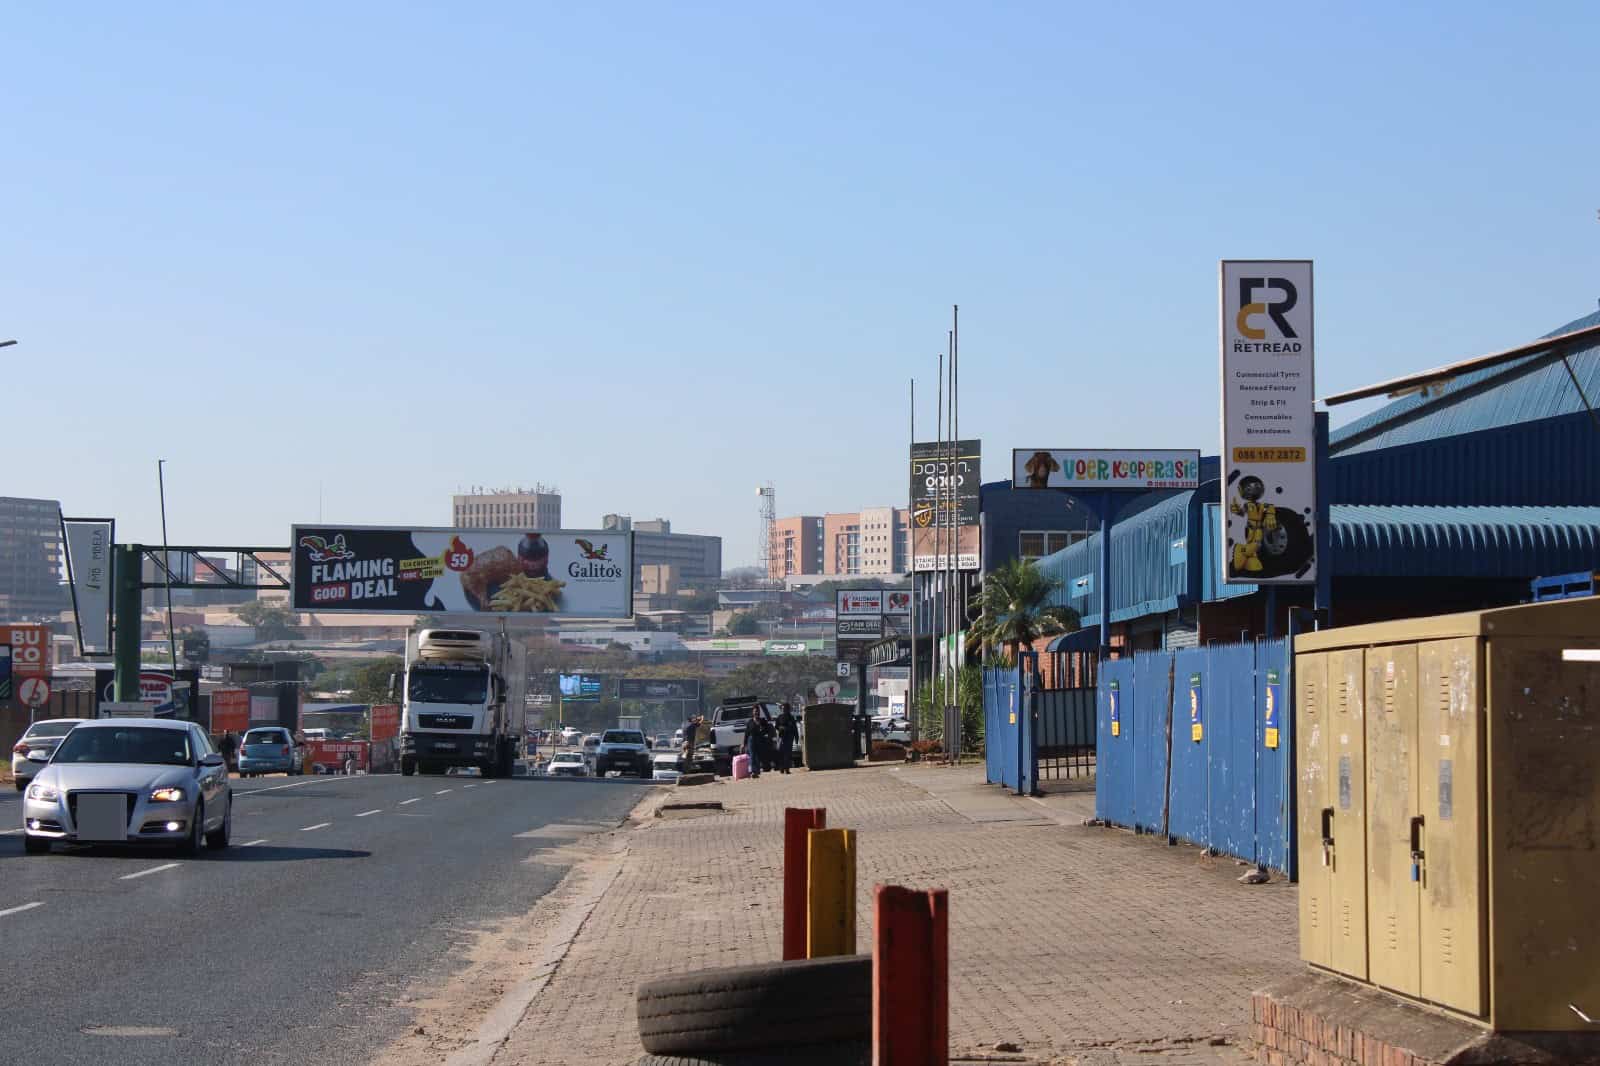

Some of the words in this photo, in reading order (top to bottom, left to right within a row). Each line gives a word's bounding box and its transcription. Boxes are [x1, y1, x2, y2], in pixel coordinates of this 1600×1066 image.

[1233, 343, 1302, 353] RETREAD
[1280, 371, 1300, 379] Tyres
[413, 559, 439, 567] CHICKEN
[450, 553, 469, 568] 59
[311, 558, 394, 584] FLAMING
[568, 561, 622, 578] Galito's
[314, 586, 346, 601] GOOD
[351, 578, 398, 600] DEAL
[11, 630, 40, 645] BU
[12, 649, 41, 662] CO
